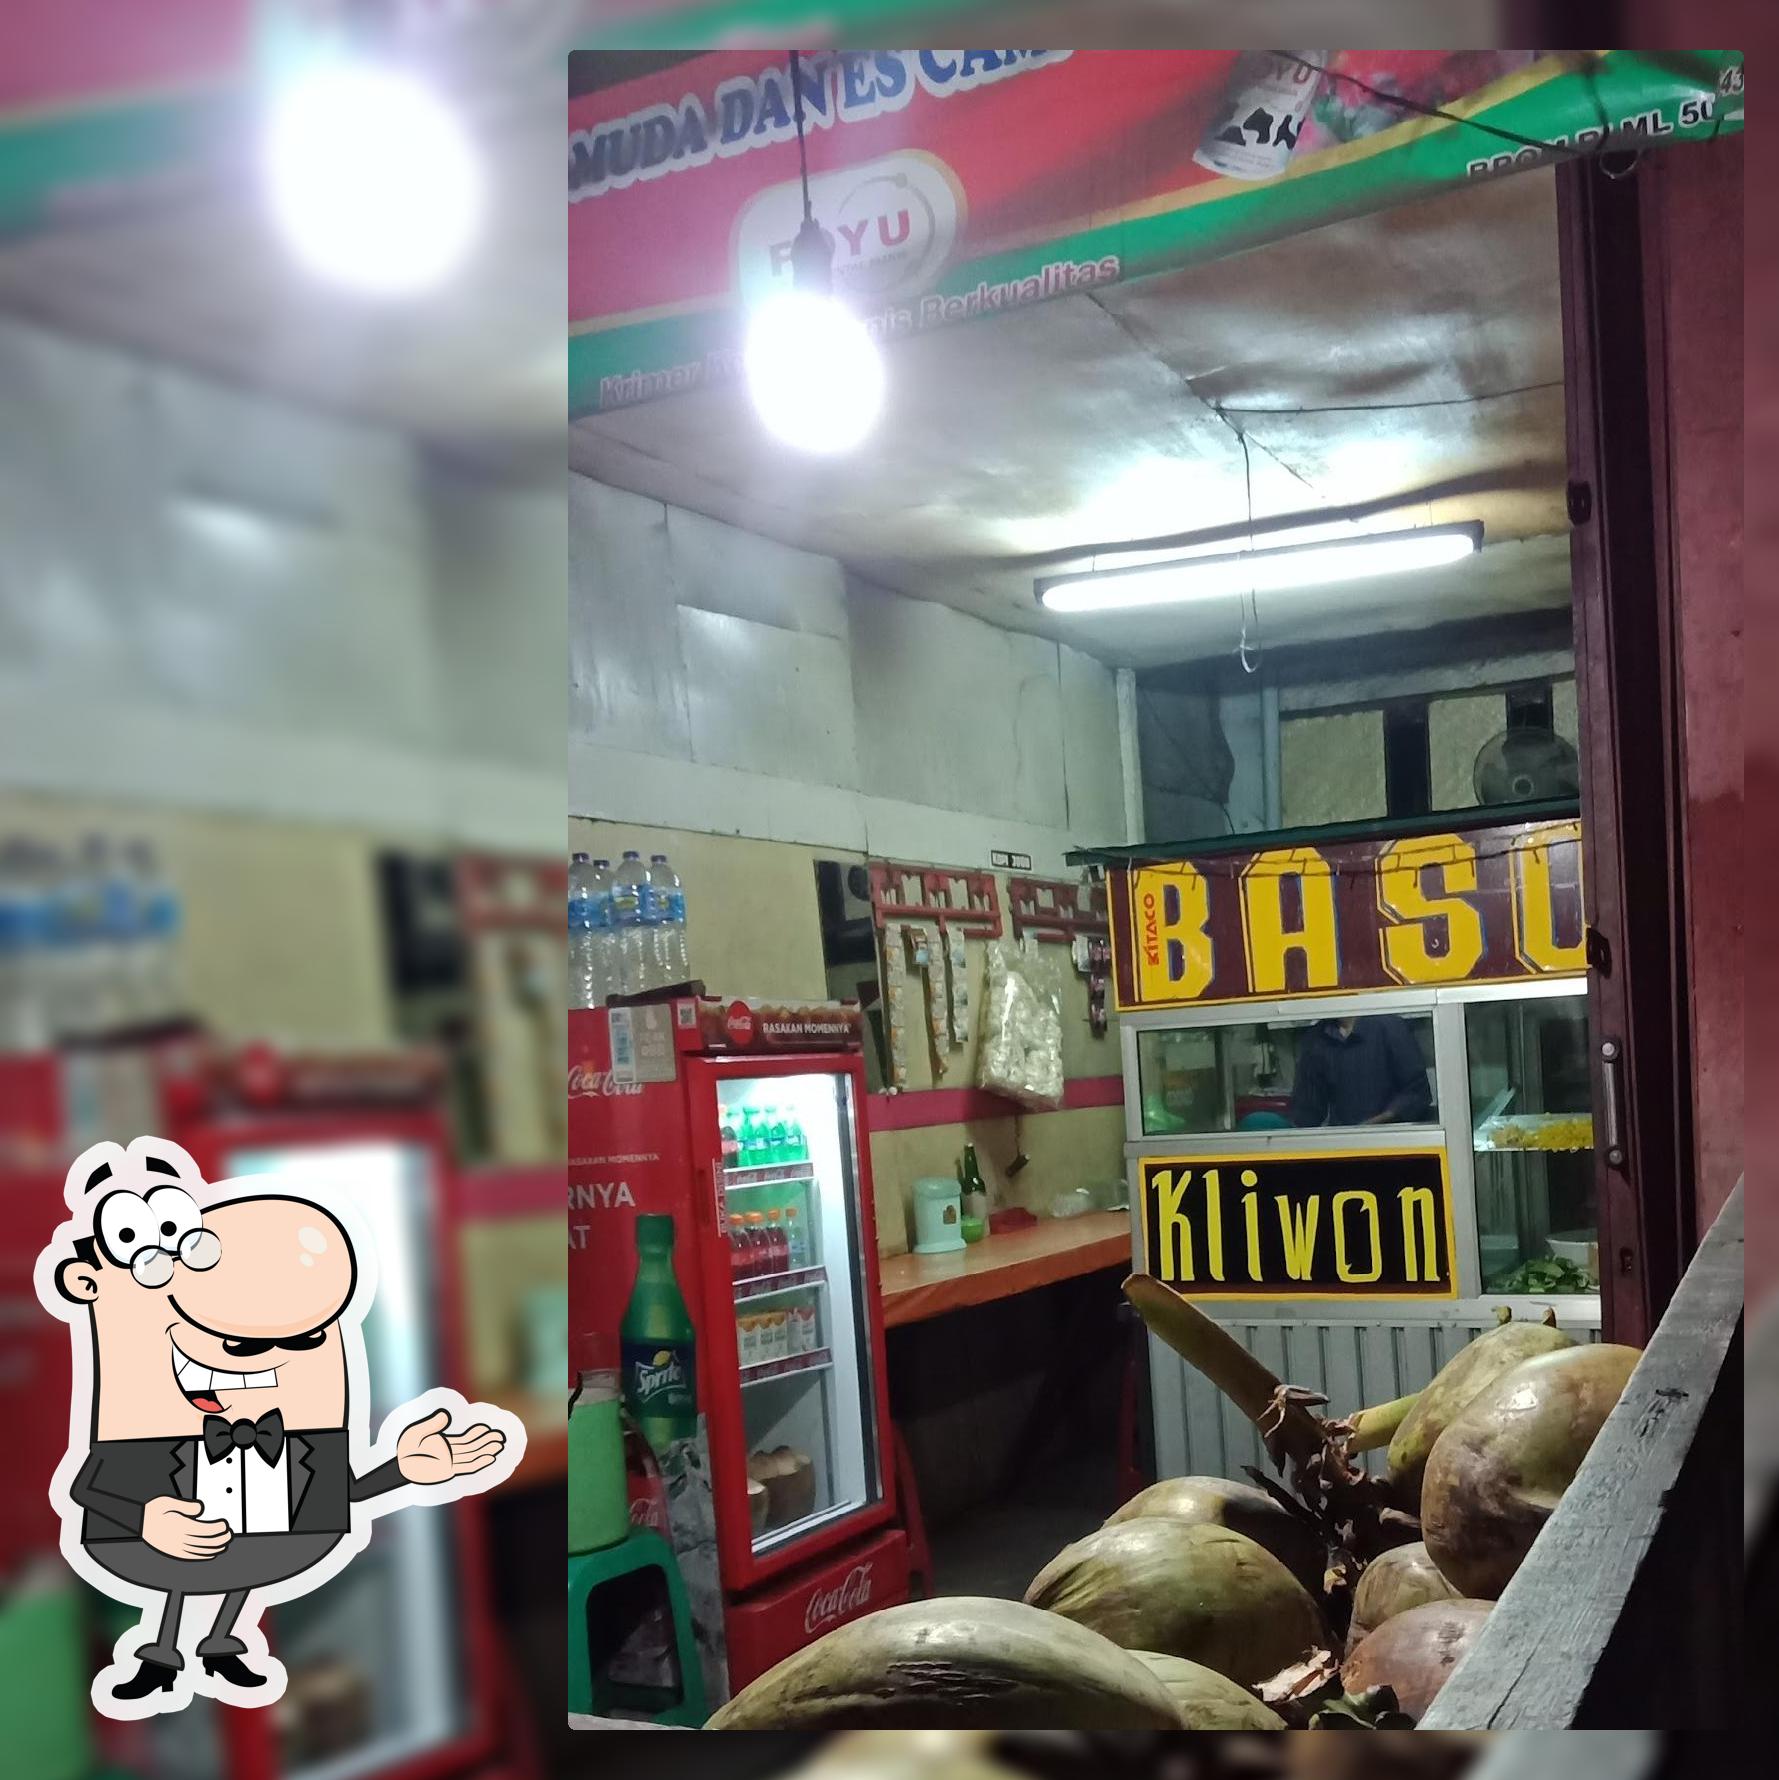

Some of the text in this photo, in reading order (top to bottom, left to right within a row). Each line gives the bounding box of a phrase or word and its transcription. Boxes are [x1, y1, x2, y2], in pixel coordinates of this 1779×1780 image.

[568, 104, 708, 191] MUDA
[720, 61, 830, 143] DAN
[844, 50, 907, 109] ES
[1622, 110, 1672, 140] ML
[920, 256, 1119, 329] Berkualitas
[1143, 892, 1159, 966] KITACO
[762, 1020, 849, 1034] RASAKAN MOMENNYA
[1152, 1169, 1441, 1284] Kliwon
[637, 1362, 682, 1396] Sprite
